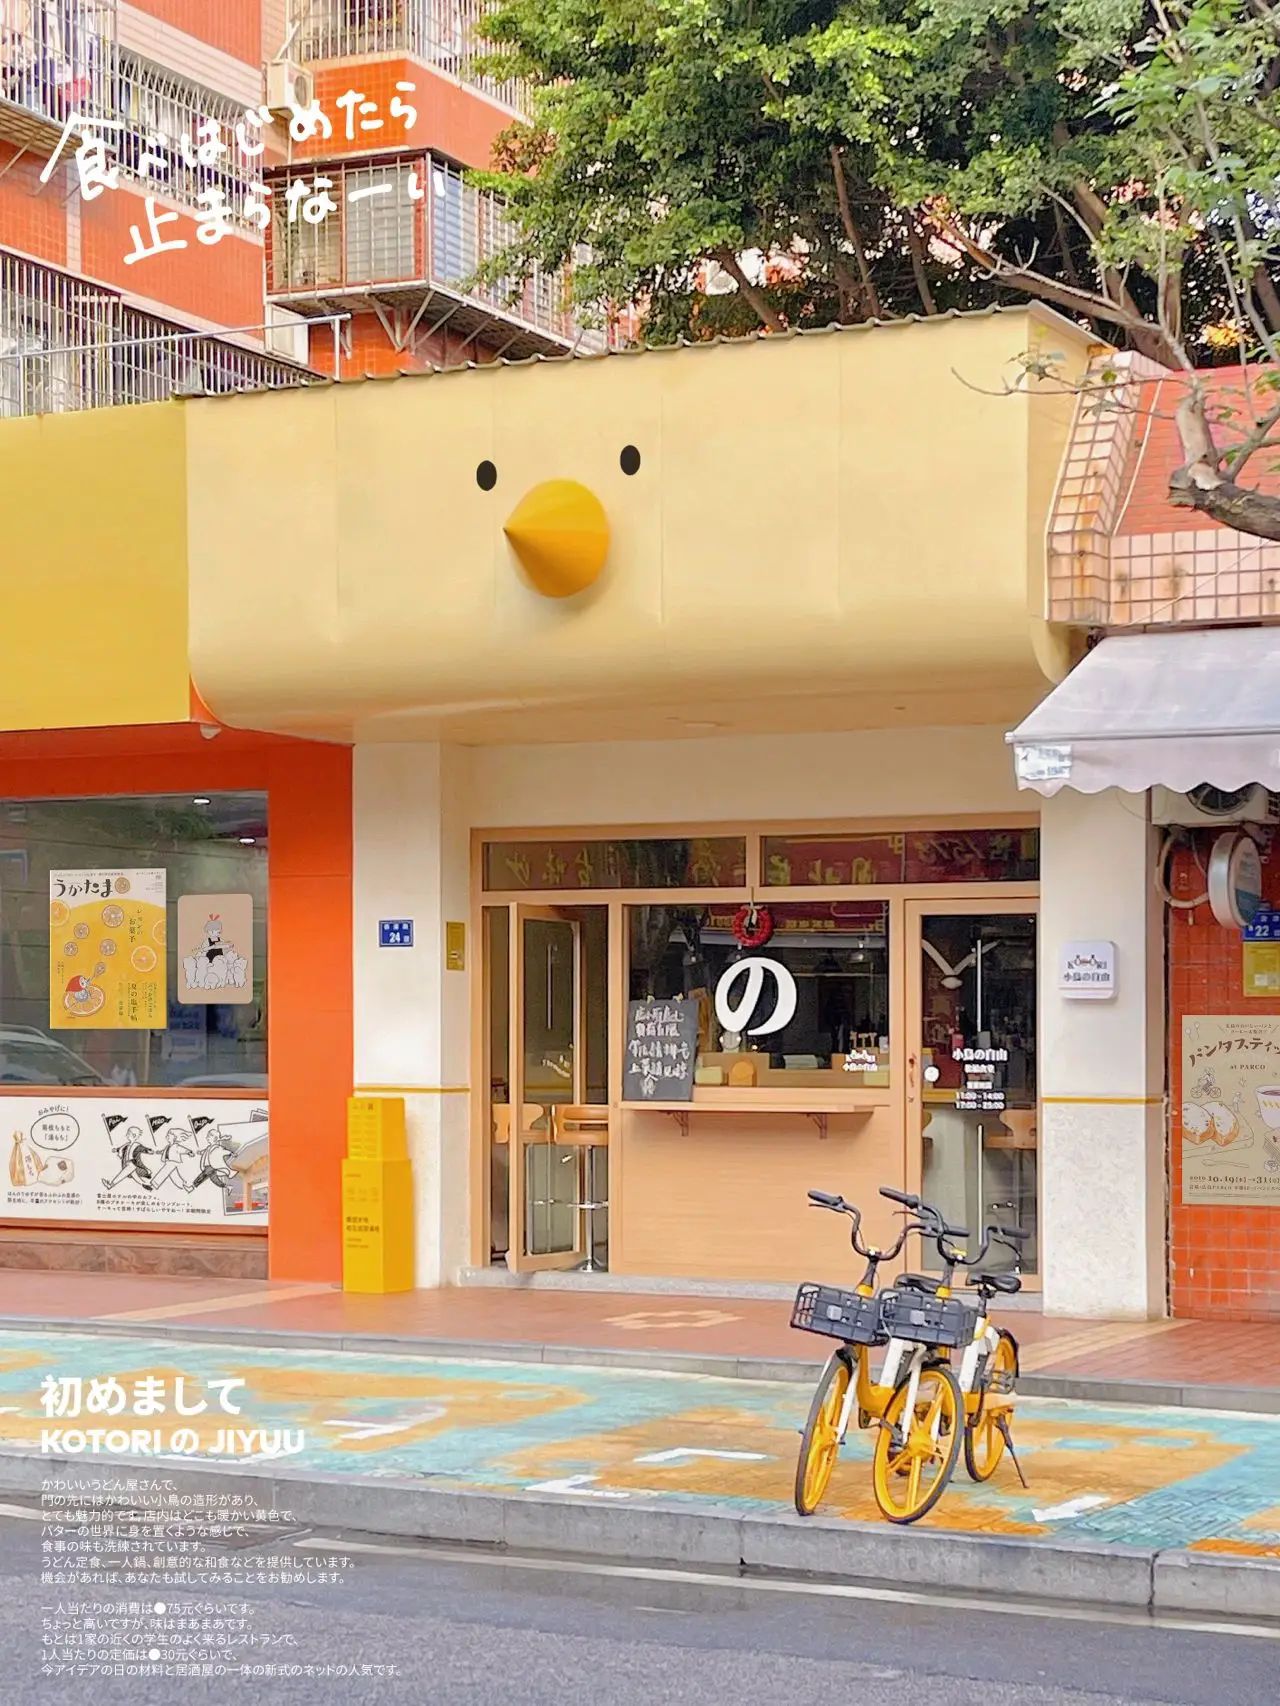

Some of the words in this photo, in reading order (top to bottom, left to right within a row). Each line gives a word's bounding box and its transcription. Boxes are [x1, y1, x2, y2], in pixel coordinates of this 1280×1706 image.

[53, 878, 114, 898] うかたま
[389, 932, 401, 943] 24
[1254, 925, 1269, 937] 22
[714, 956, 797, 1036] の
